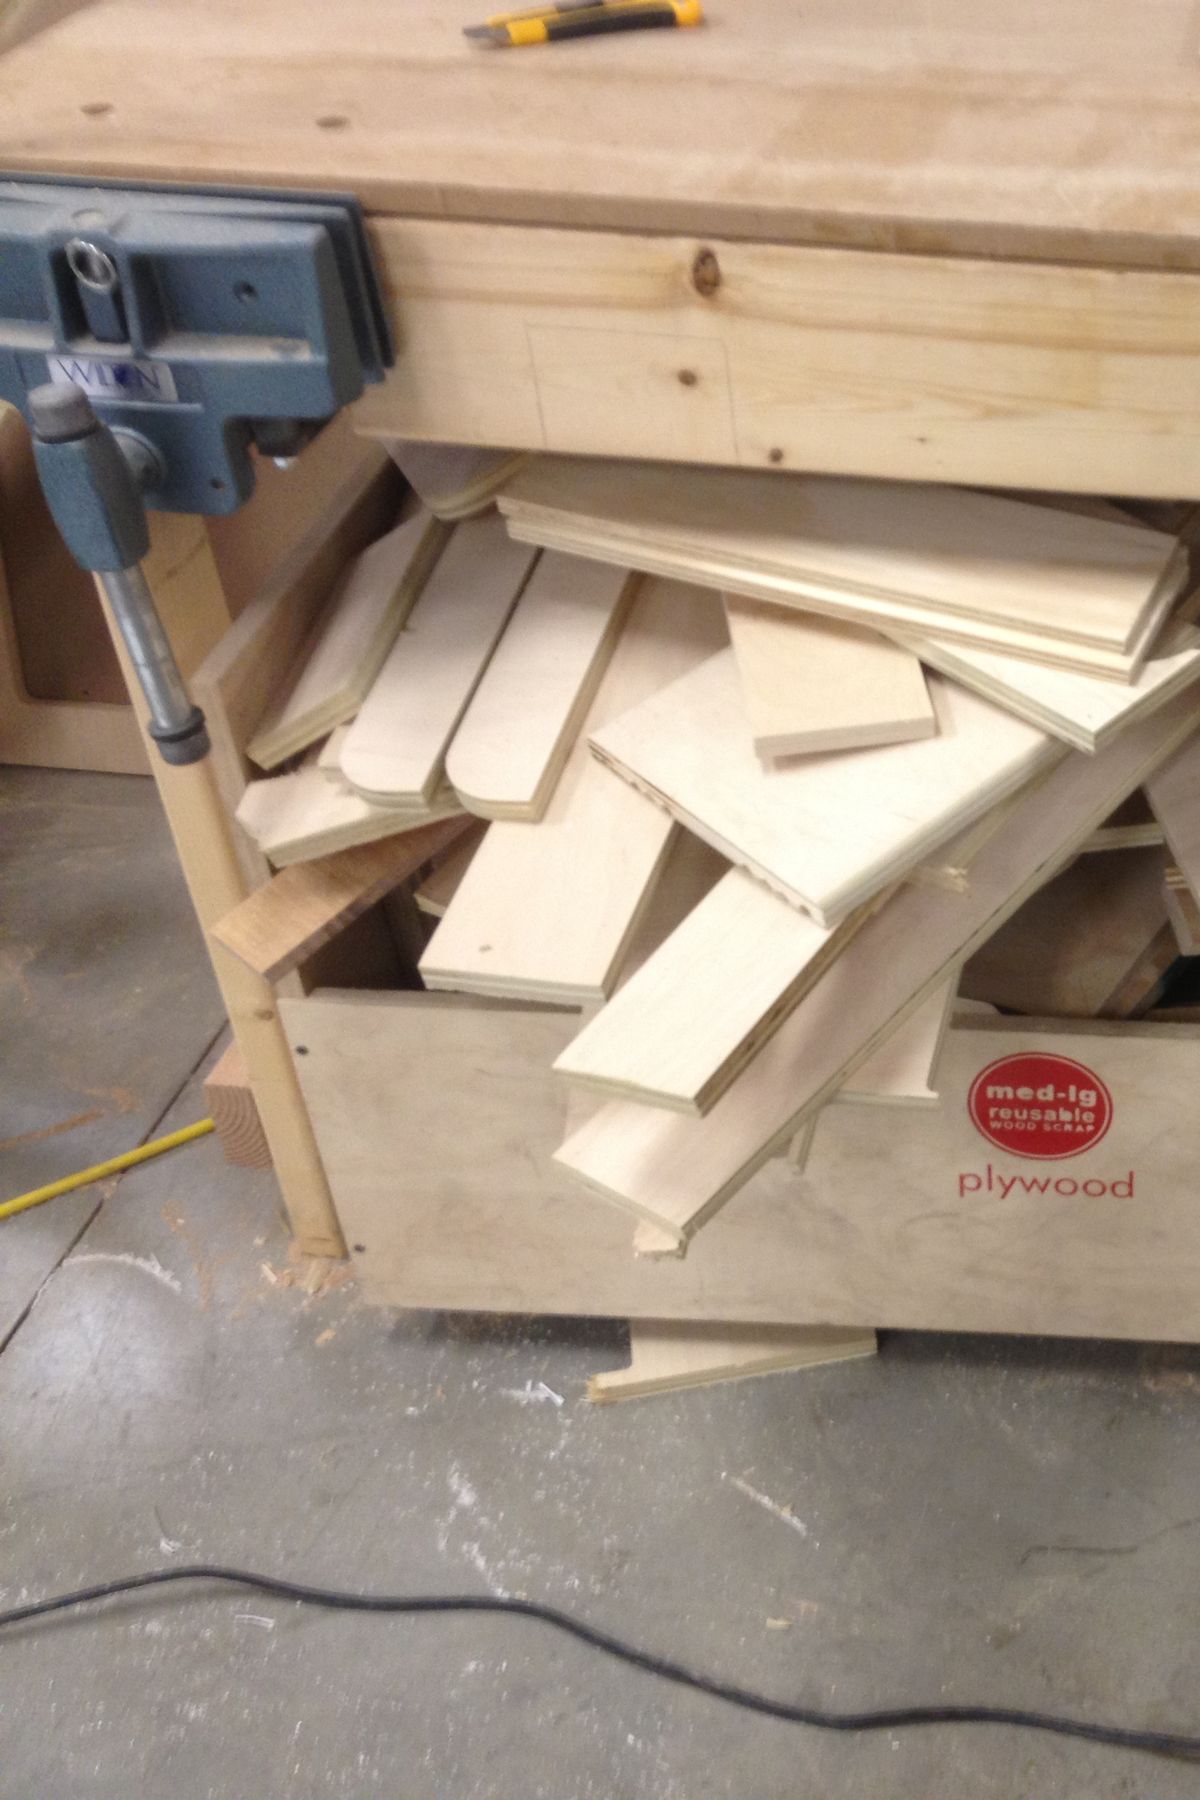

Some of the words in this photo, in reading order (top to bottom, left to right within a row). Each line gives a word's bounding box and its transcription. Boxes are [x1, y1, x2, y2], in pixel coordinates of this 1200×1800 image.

[986, 1083, 1098, 1108] med-lg
[988, 1107, 1096, 1123] reusable
[989, 1120, 1037, 1131] WOOD
[1043, 1122, 1096, 1133] SCRAP
[959, 1163, 1135, 1200] plywood
